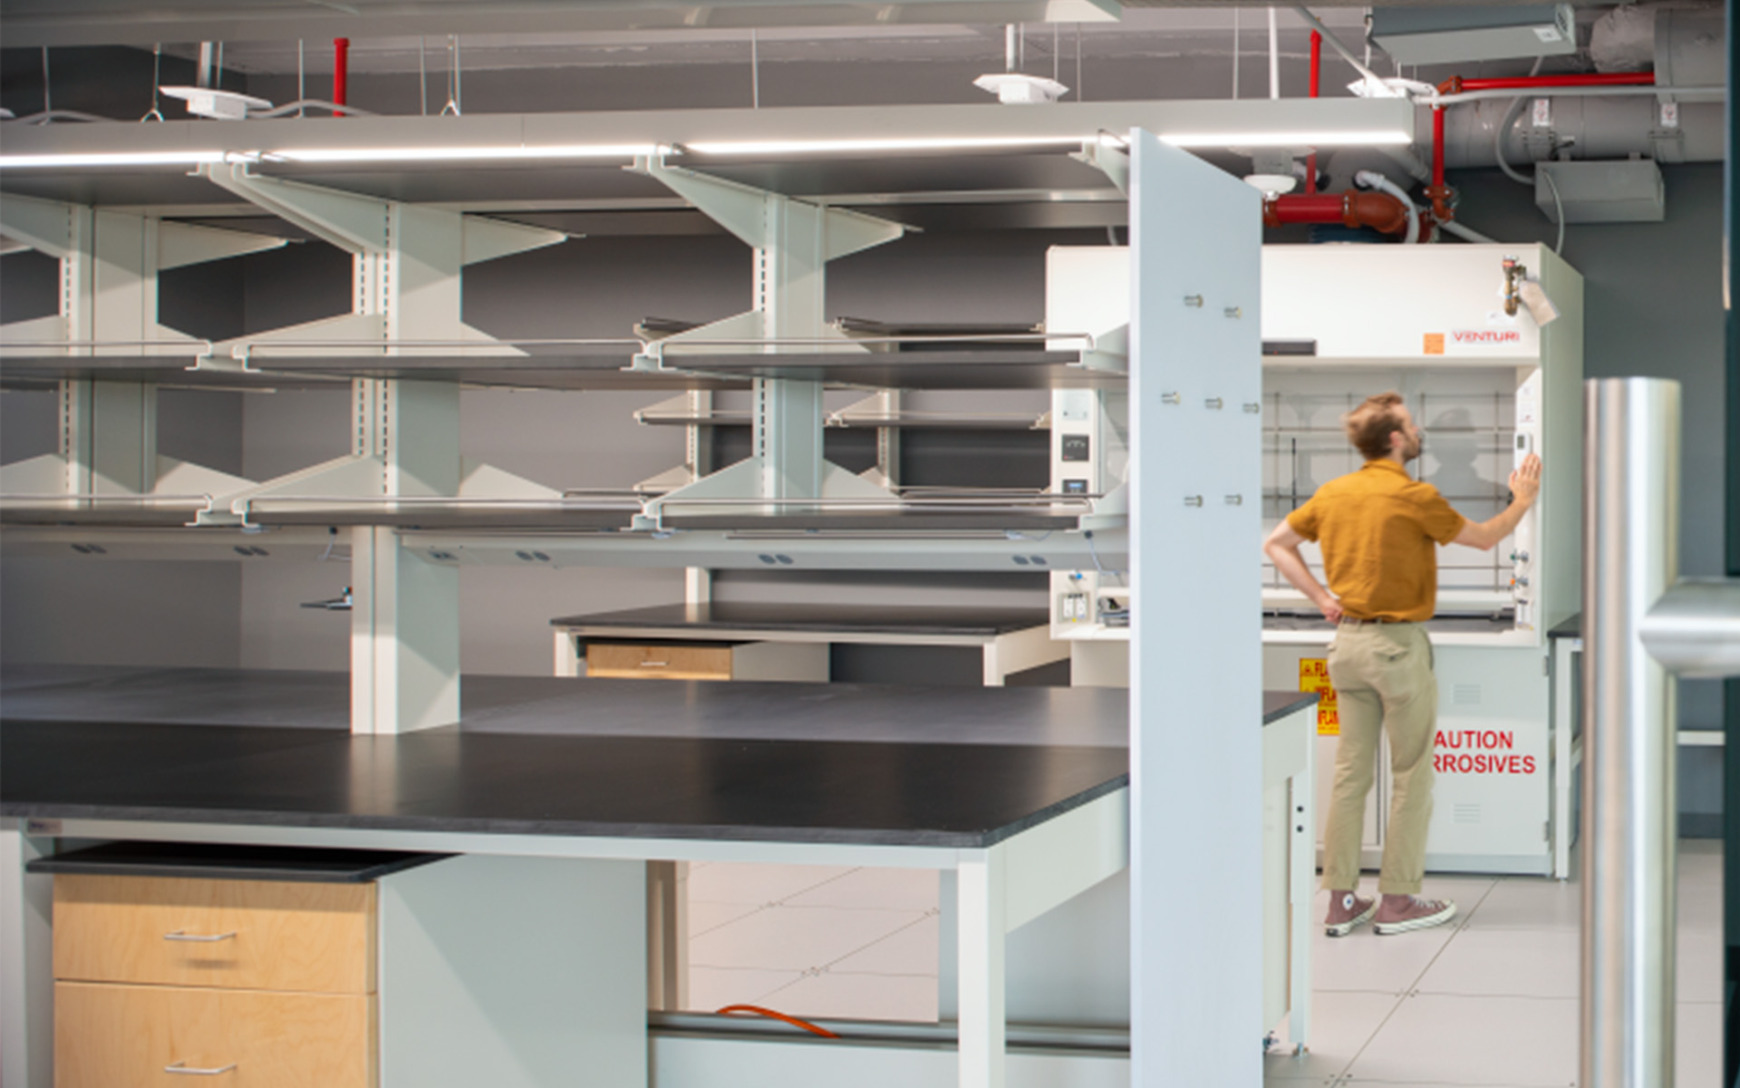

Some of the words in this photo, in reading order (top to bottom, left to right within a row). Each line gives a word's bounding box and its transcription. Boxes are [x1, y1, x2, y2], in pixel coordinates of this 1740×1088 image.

[1453, 330, 1520, 343] VENTURI
[1434, 730, 1513, 749] AUTION
[1433, 753, 1536, 774] RROSIVES
